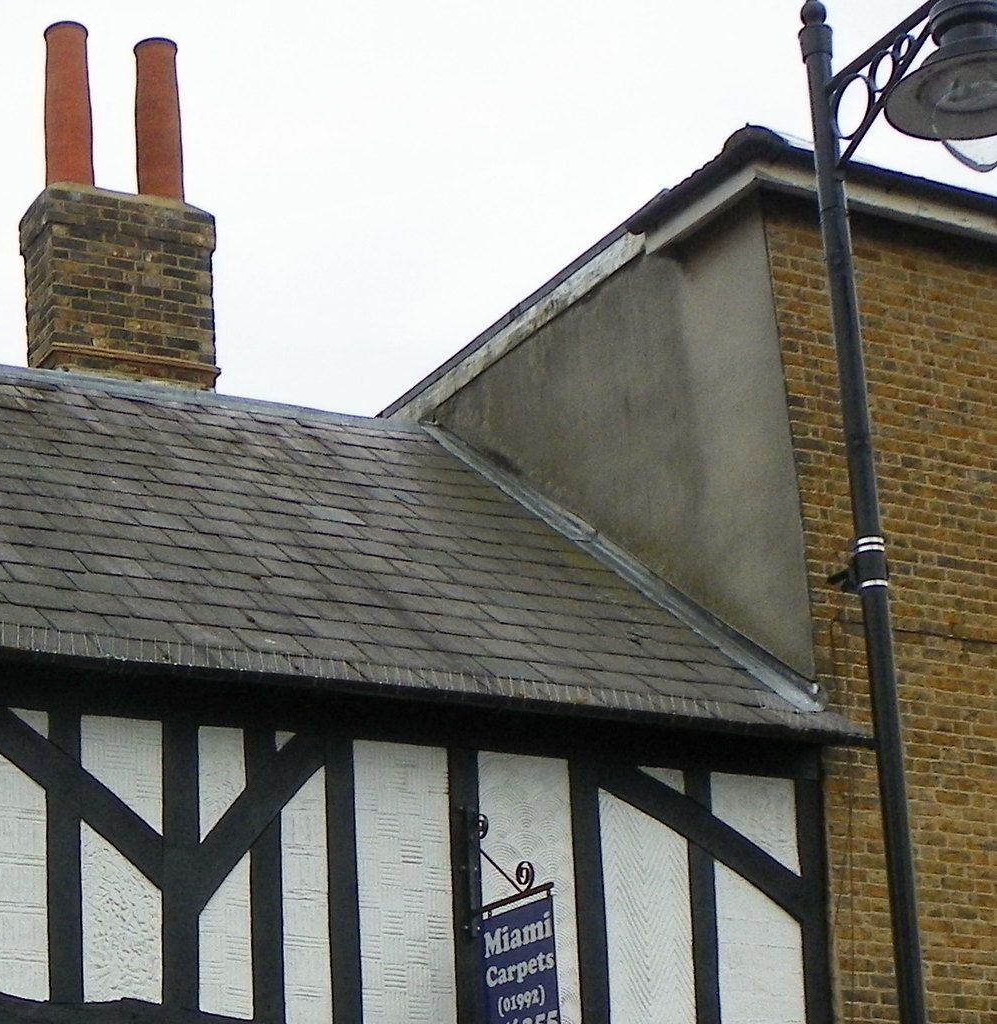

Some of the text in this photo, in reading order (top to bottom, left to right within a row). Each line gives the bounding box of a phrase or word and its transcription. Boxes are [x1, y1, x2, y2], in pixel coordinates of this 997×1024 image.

[483, 911, 553, 959] Miami
[485, 952, 556, 988] Carpets
[497, 984, 546, 1017] (01992)
